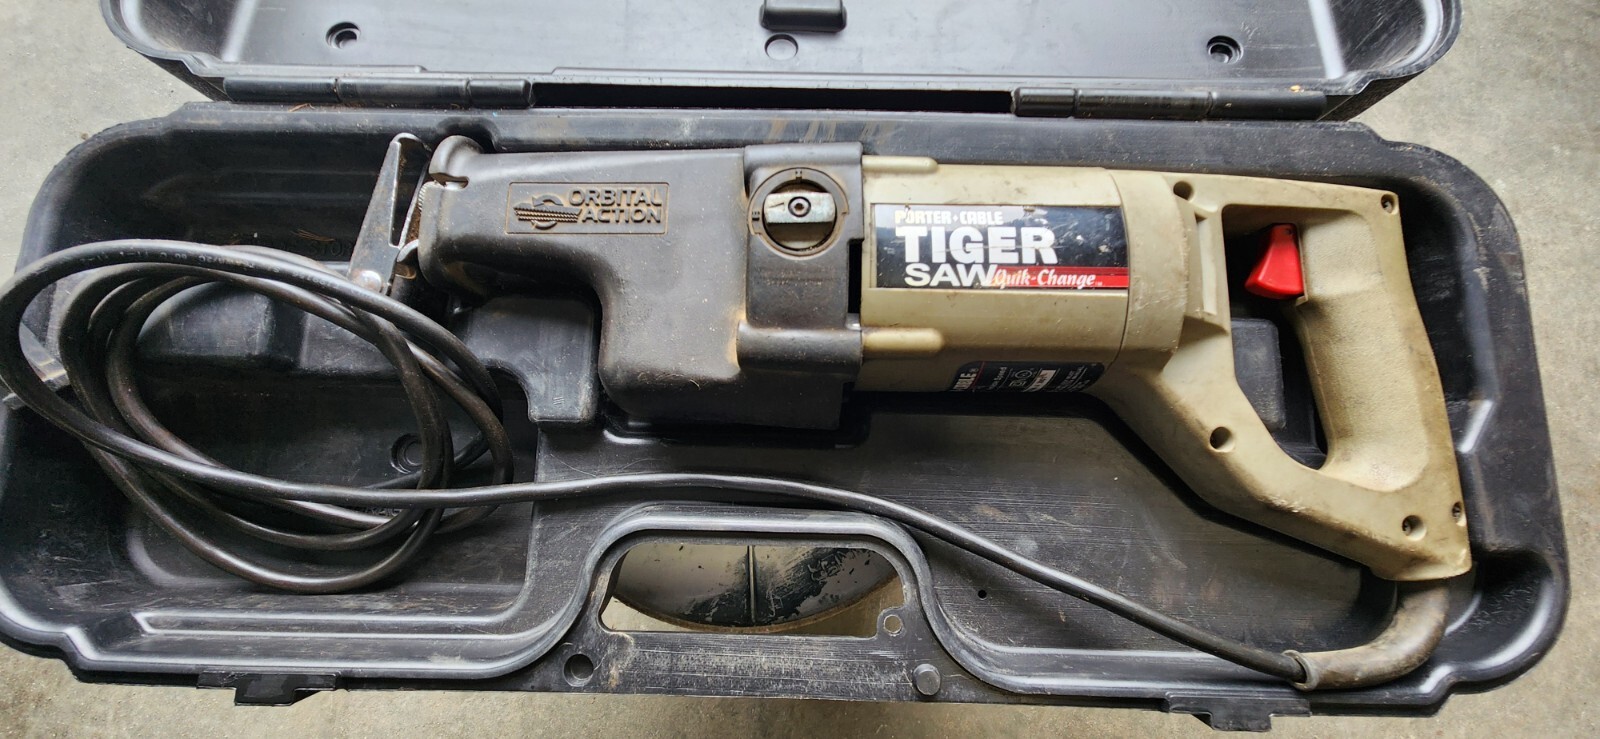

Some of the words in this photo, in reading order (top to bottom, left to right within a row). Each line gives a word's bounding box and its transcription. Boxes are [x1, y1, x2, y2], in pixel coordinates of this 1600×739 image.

[569, 189, 663, 206] ORBITAL
[582, 208, 661, 223] ACTION
[895, 226, 1058, 264] TIGER
[904, 263, 997, 287] SAW
